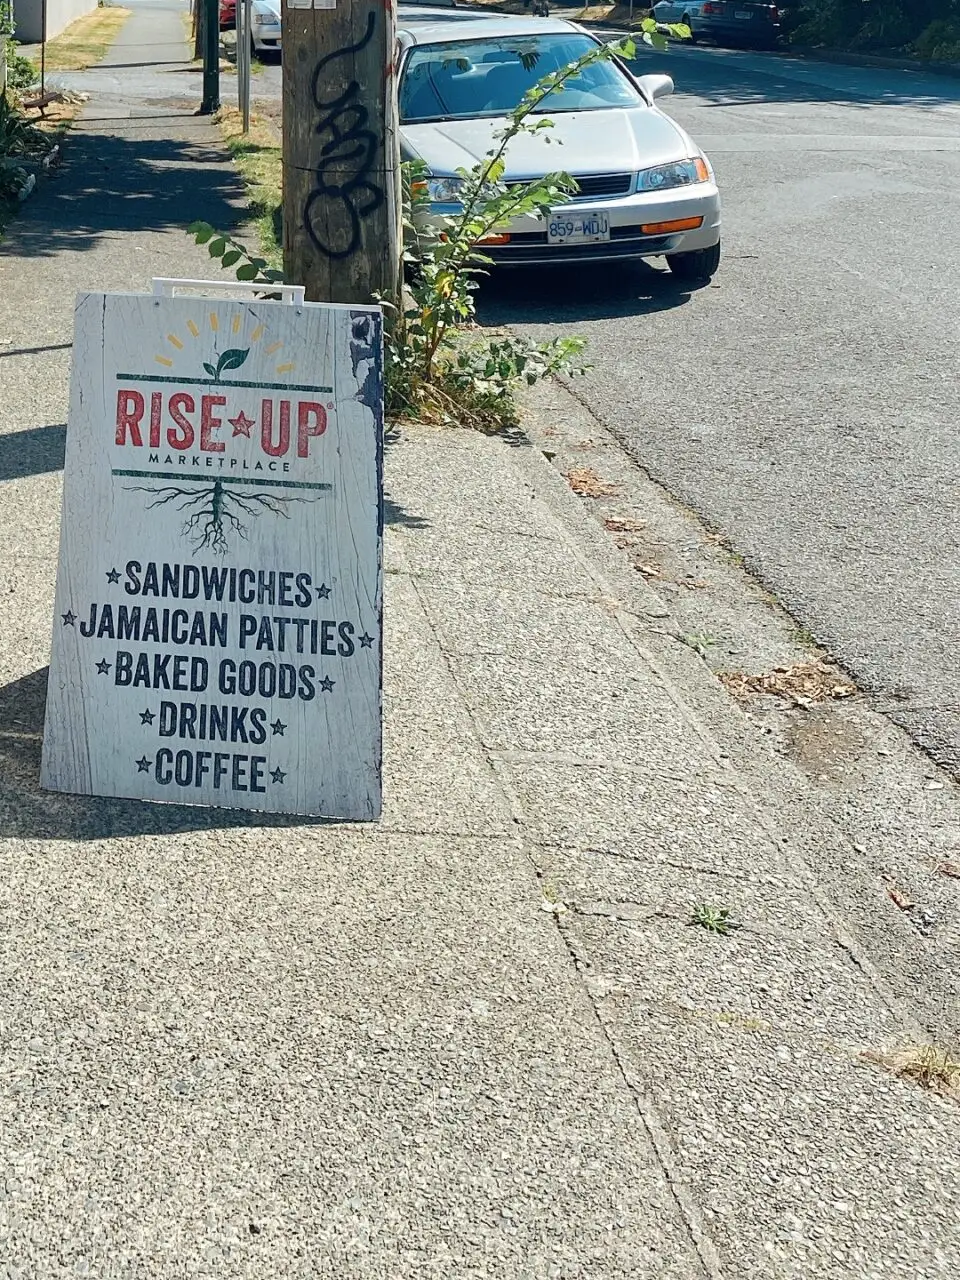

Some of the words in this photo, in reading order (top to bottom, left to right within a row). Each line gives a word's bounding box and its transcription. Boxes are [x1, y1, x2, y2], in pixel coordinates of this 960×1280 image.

[115, 389, 227, 453] RISE
[148, 452, 291, 473] MARKETPLACE
[123, 560, 313, 608] SANDWICHES
[79, 603, 229, 648] JAMAICAN
[238, 613, 356, 658] PATTIES
[114, 650, 209, 692] BAKED
[218, 658, 316, 701] GOODS
[158, 700, 268, 745] DRINKS
[154, 747, 267, 793] COFFEE
